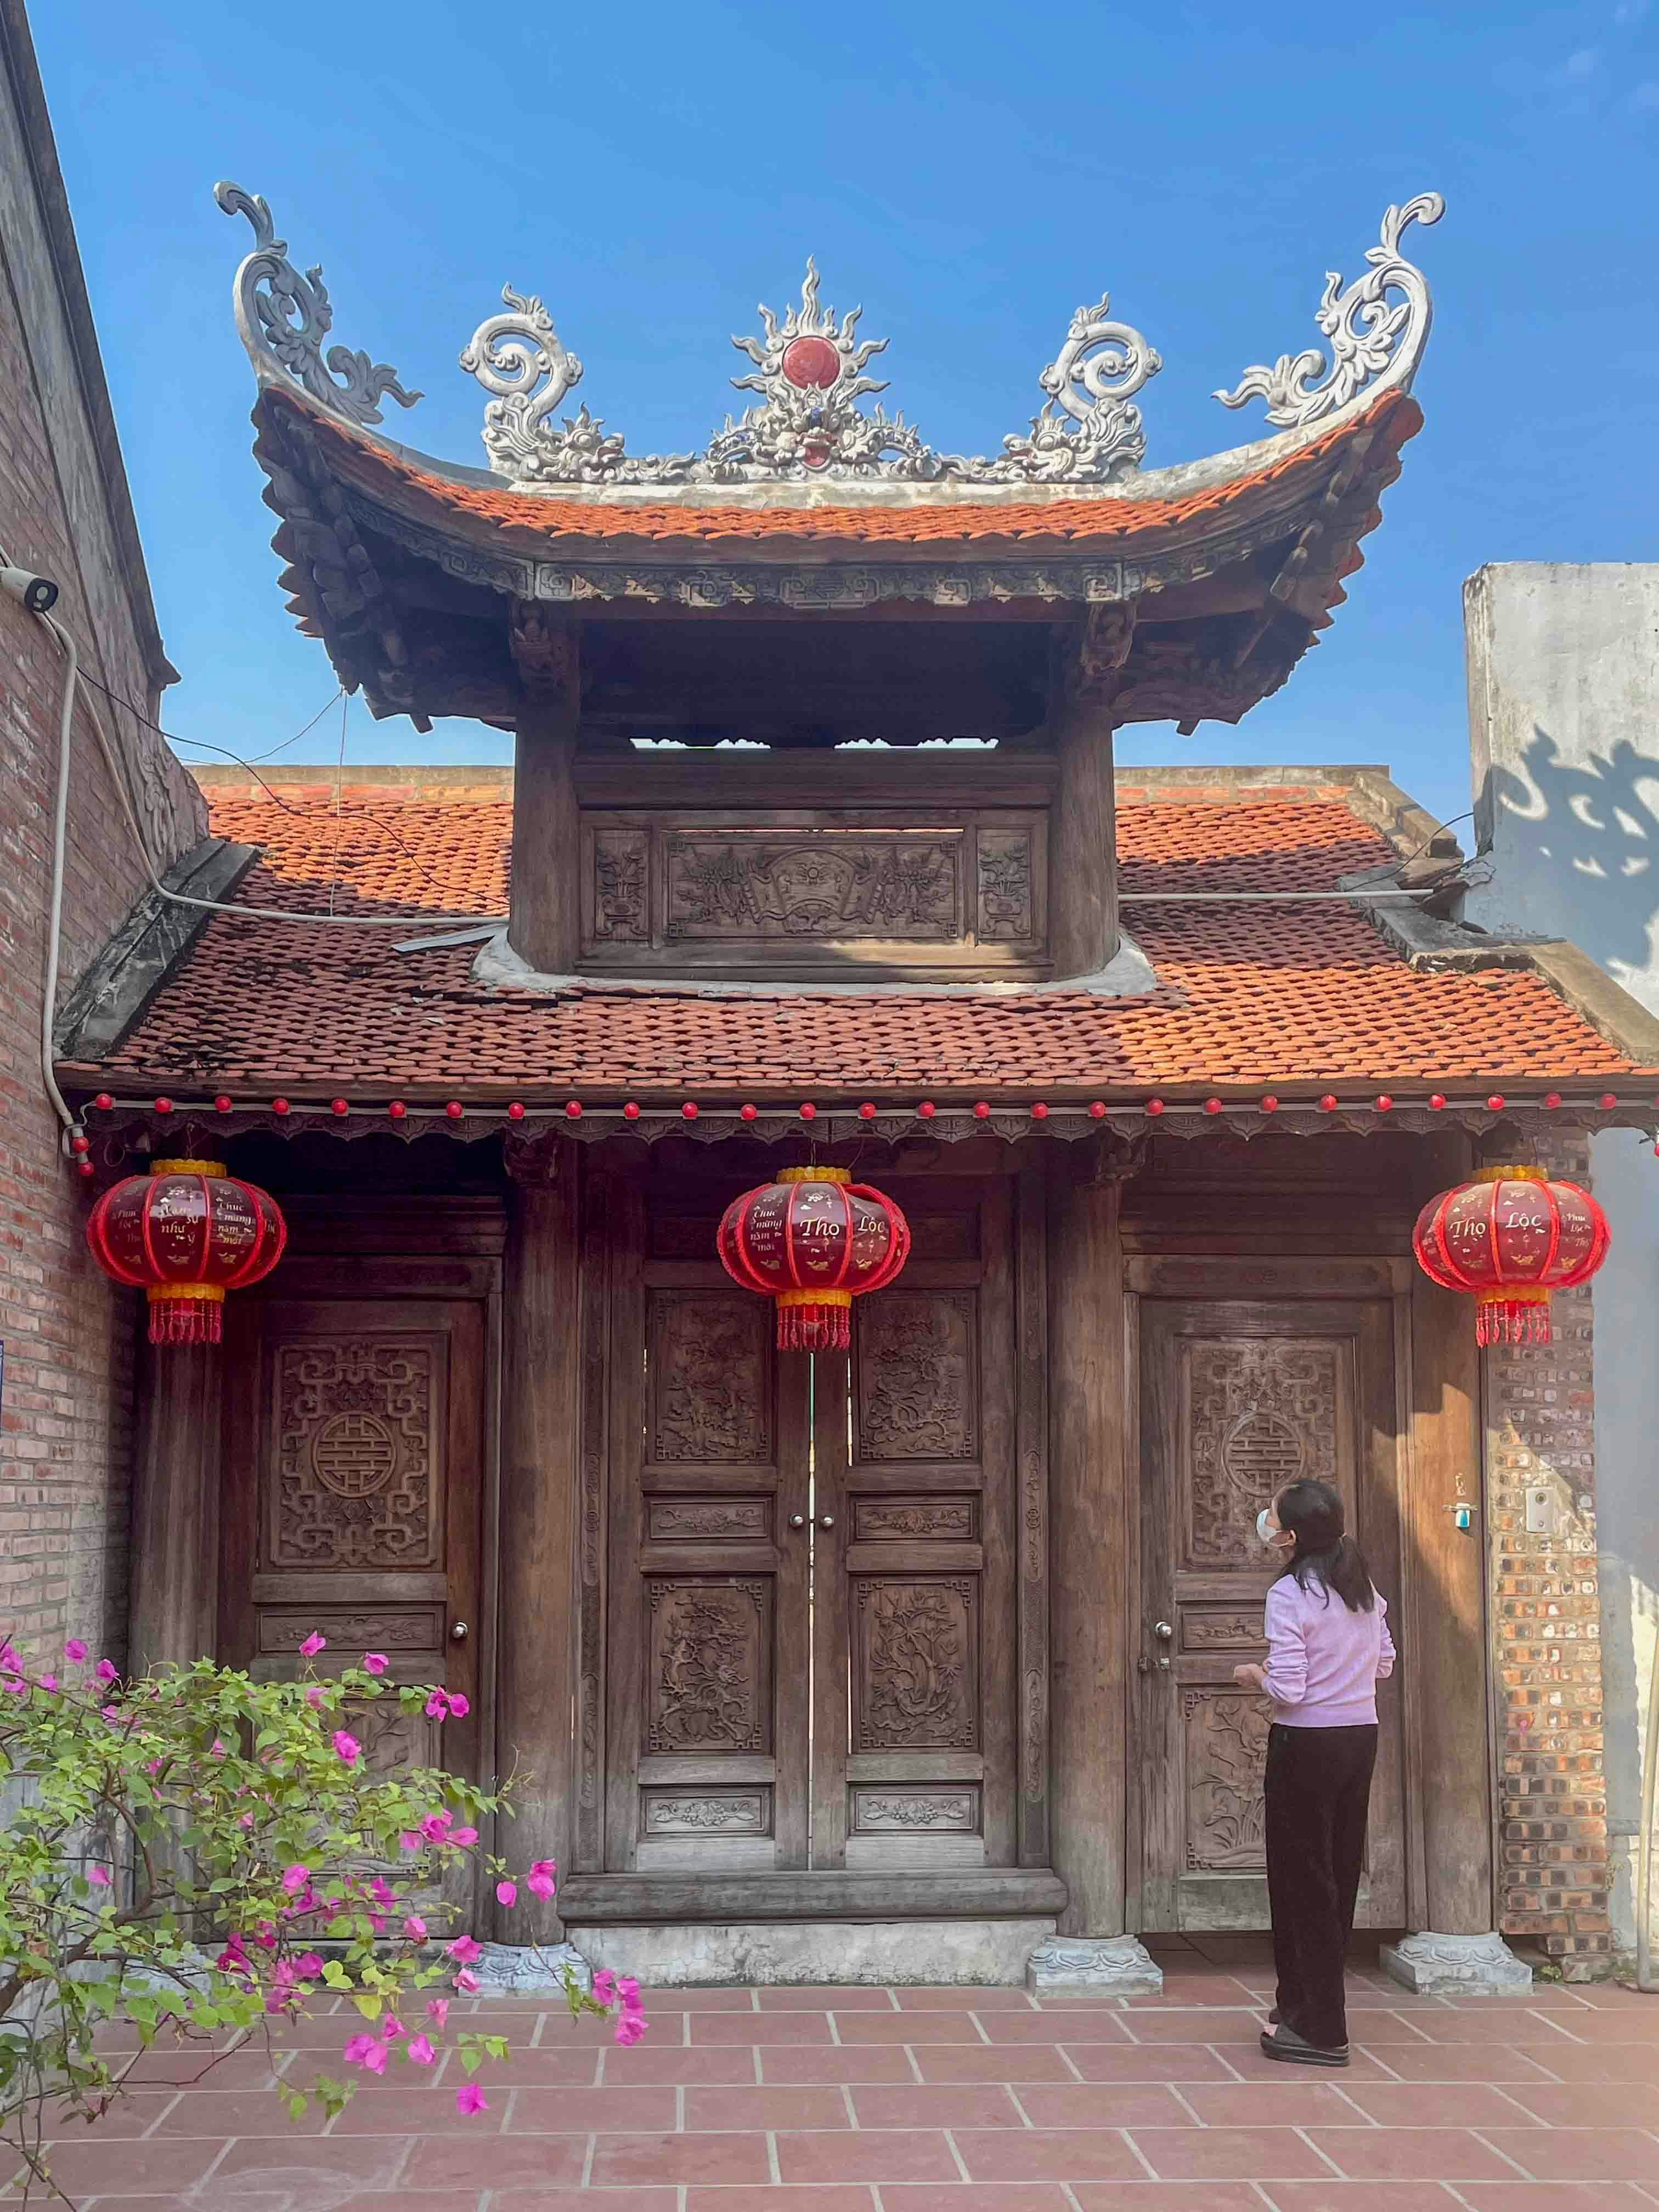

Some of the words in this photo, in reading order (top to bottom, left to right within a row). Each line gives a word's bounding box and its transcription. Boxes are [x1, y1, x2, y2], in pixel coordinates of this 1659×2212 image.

[799, 1216, 840, 1239] Thọ
[1448, 1216, 1486, 1238] Thọ
[1505, 1211, 1542, 1231] Lộc
